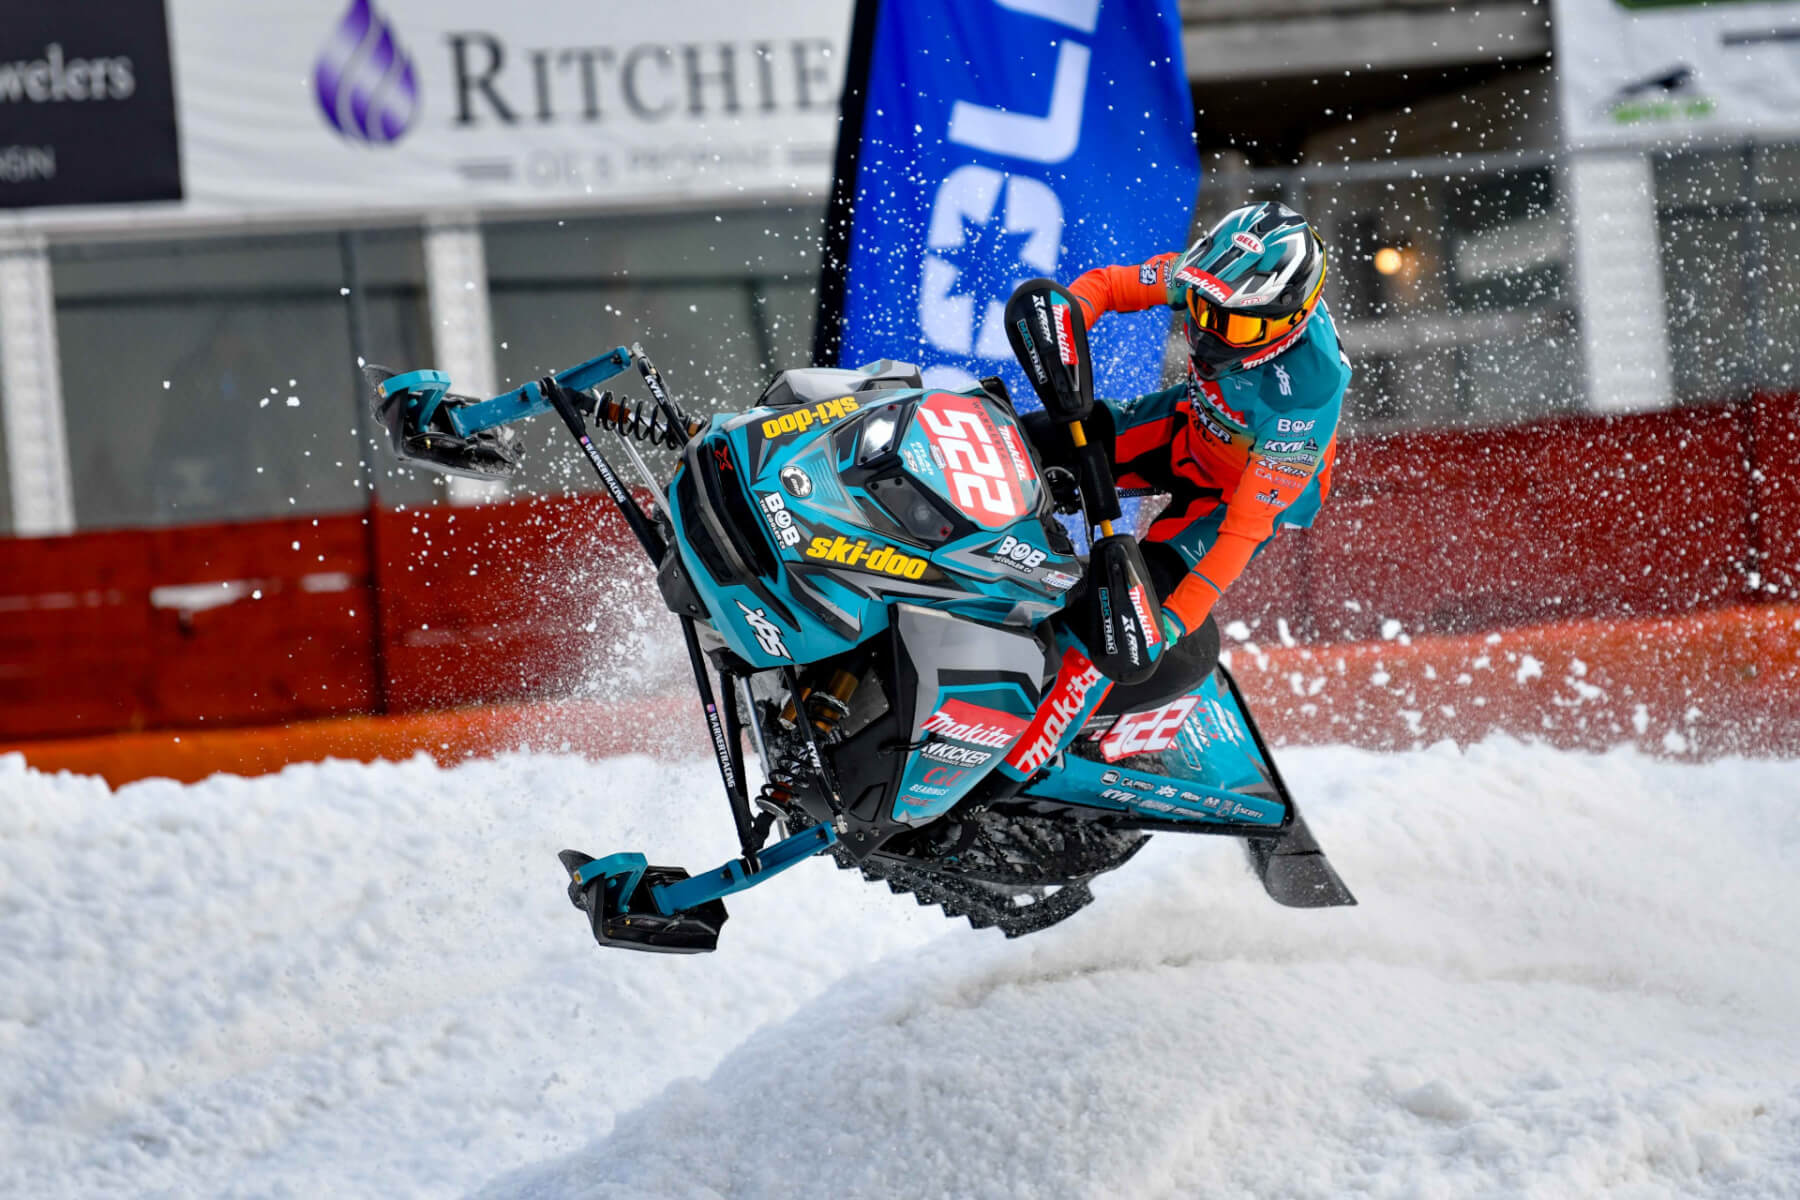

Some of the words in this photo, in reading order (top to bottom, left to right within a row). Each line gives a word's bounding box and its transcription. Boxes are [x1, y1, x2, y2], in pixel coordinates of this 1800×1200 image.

[446, 32, 835, 127] RITCHIE
[1236, 234, 1260, 251] BELL
[1176, 268, 1228, 303] makita
[1052, 304, 1072, 366] makita
[761, 396, 860, 440] ski-doo
[917, 406, 1017, 516] 522
[805, 535, 929, 580] ski-doo
[997, 535, 1048, 569] BOB
[1129, 586, 1155, 648] makita
[920, 711, 1014, 749] makita
[1015, 664, 1103, 771] makita
[1102, 696, 1201, 759] 522
